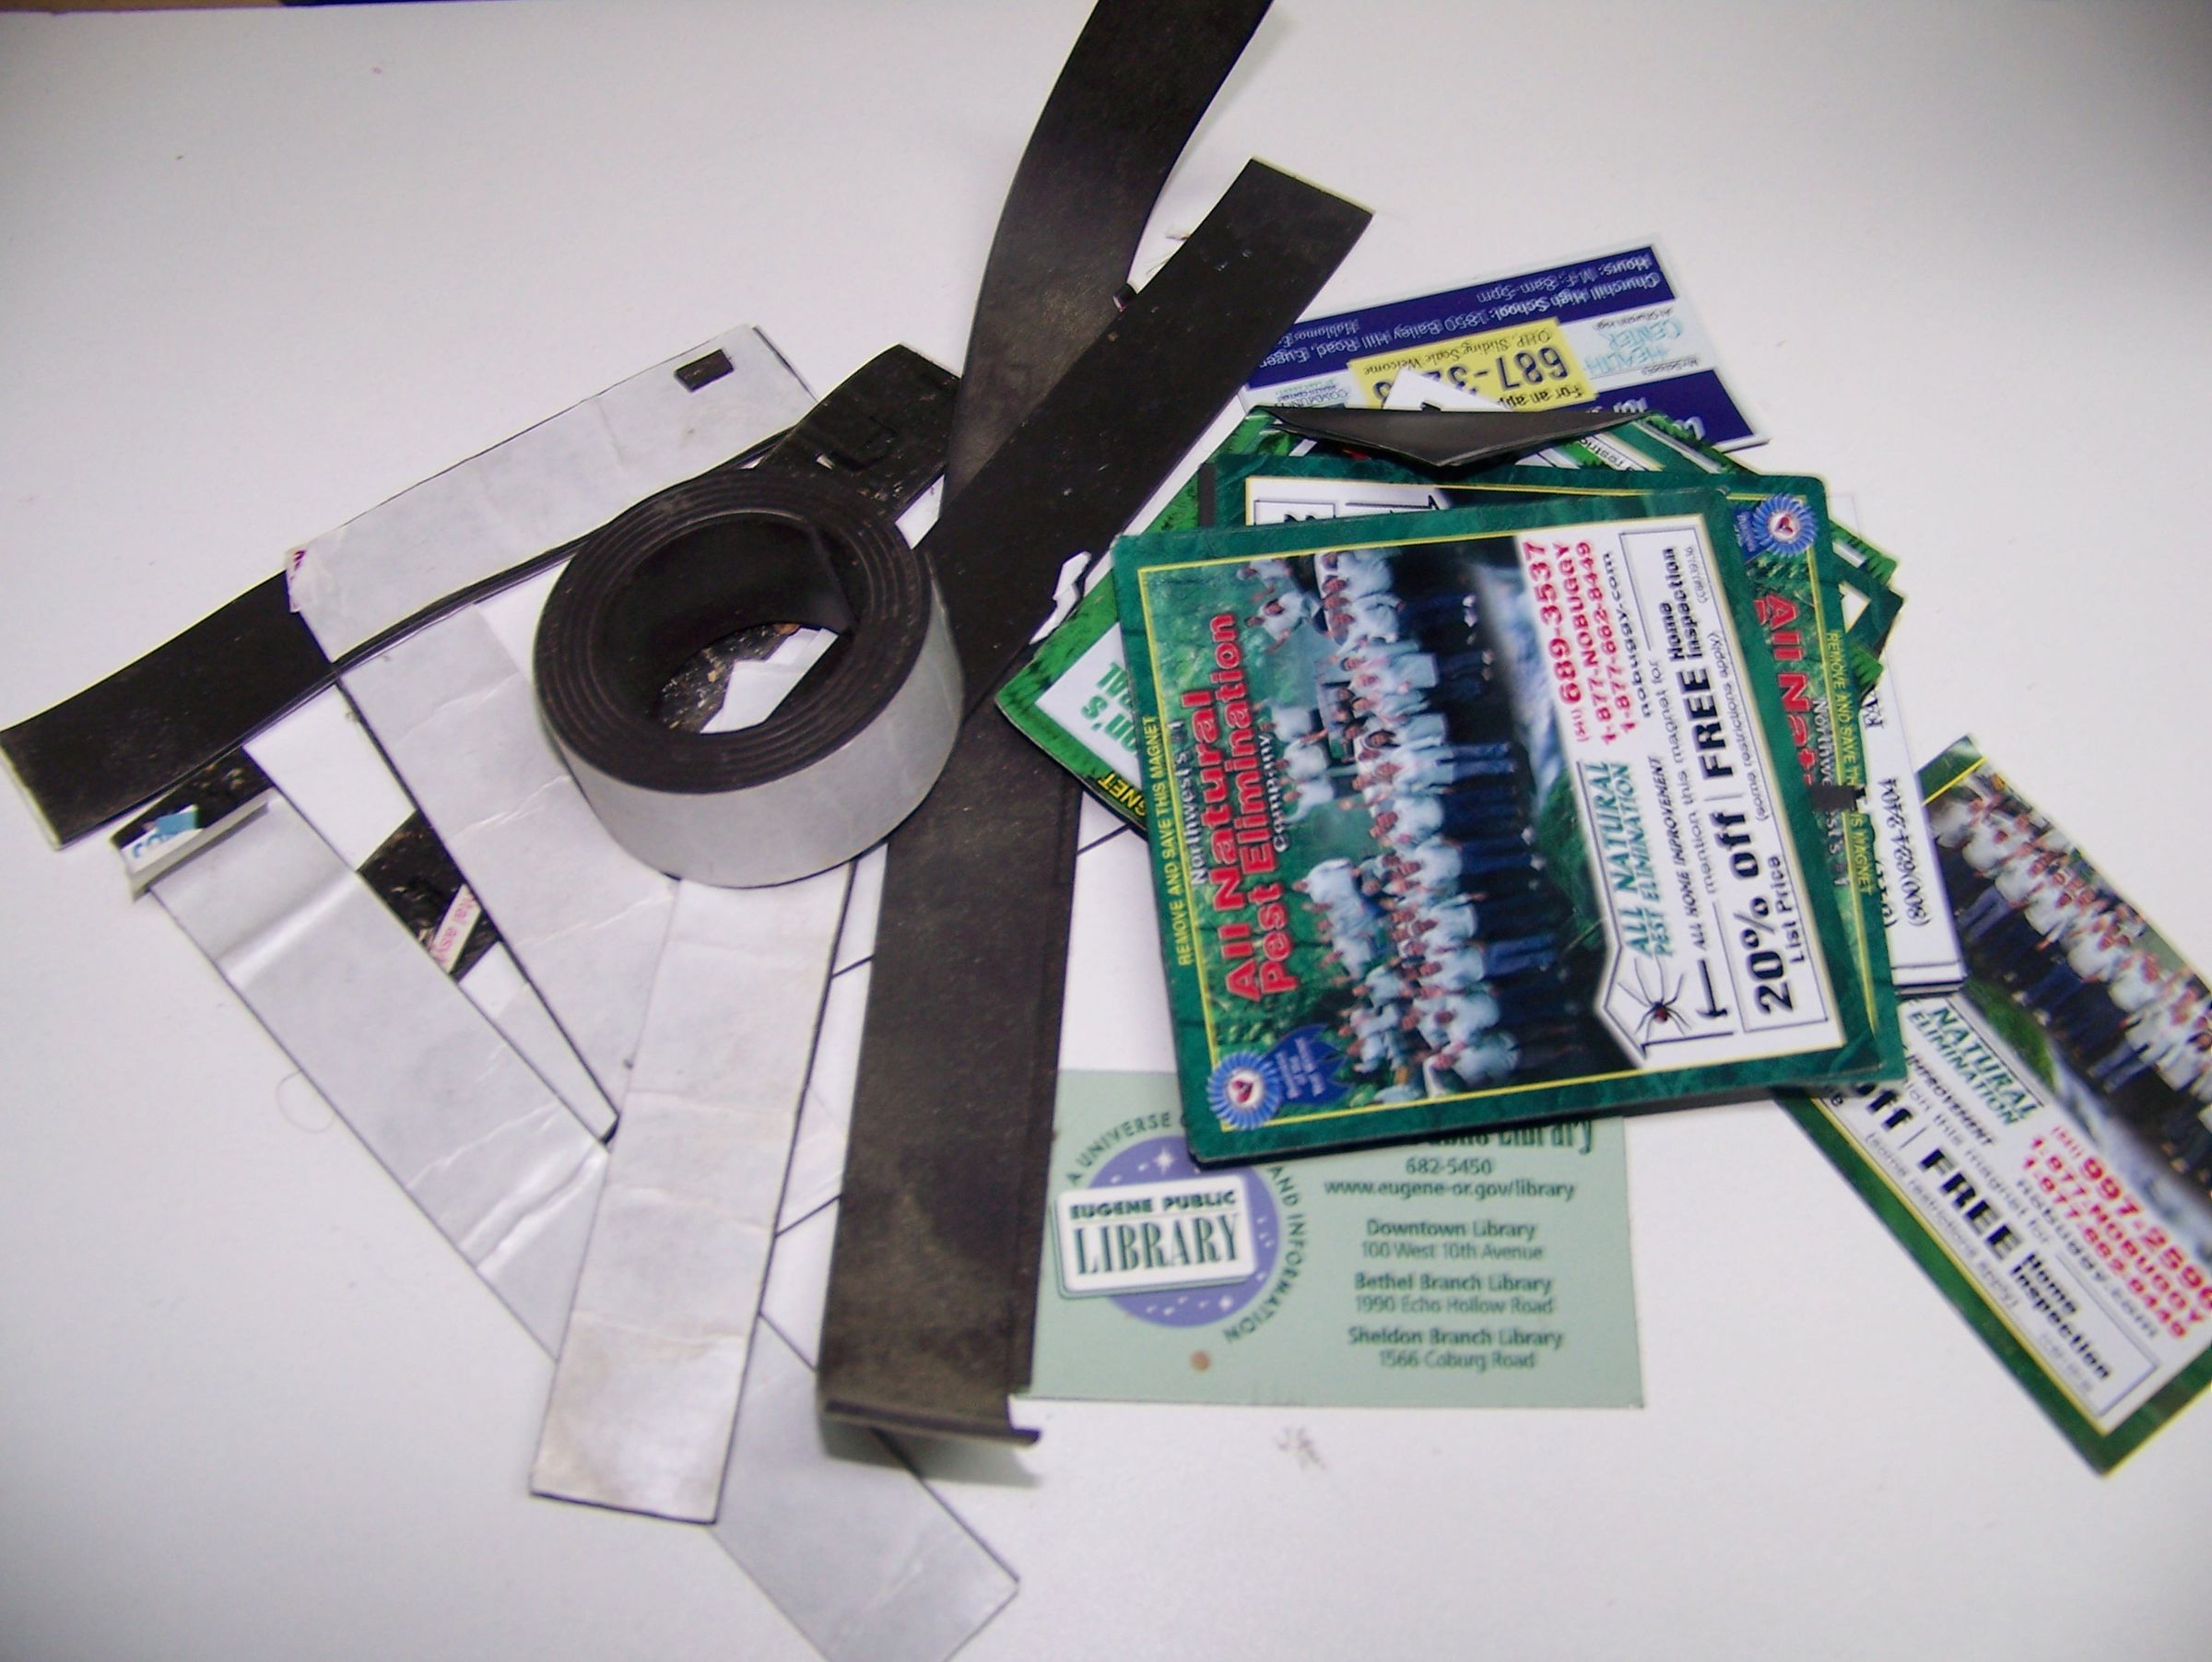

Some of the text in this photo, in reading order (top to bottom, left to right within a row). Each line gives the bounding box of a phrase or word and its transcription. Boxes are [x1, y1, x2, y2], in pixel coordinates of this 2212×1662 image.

[1548, 285, 1591, 310] High
[1588, 270, 1663, 301] Churchill
[1596, 253, 1655, 280] Hours:
[1293, 317, 1359, 348] Hablamos
[1360, 330, 1391, 350] Hill
[1392, 313, 1444, 344] Bailey
[1442, 309, 1488, 333] 1850
[1488, 295, 1551, 324] School:
[1598, 317, 1681, 353] CENTER
[1311, 333, 1360, 361] Road,
[1363, 354, 1421, 381] Welcome
[1424, 347, 1460, 366] Scale
[1460, 333, 1508, 358] Sliding
[1583, 343, 1669, 377] HEALTH
[1529, 391, 1550, 405] an
[1552, 383, 1583, 402] For
[1522, 538, 1583, 704] 689-3537
[1599, 551, 1654, 718] nobuggy.com
[1654, 601, 1685, 661] Home
[1658, 546, 1707, 659] Inspection
[1764, 594, 1804, 661] All
[1552, 539, 1618, 745] 1-877-NOBUGGY
[1574, 540, 1639, 734] 1-877-662-8449
[1825, 630, 1847, 690] REMOVE
[1675, 667, 1735, 779] FREE
[1705, 630, 1770, 821] (some restrictions apply)
[1833, 691, 1852, 724] AND
[1838, 725, 1857, 761] SAVE
[1202, 611, 1299, 994] Pest Elimination
[1255, 731, 1291, 854] Company
[1645, 659, 1718, 894] mention this magnet for
[1140, 713, 1194, 966] REMOVE AND SAVE THIS MAGNET
[1171, 751, 1209, 886] Northwest's
[1179, 688, 1262, 1004] All Natural
[1583, 759, 1653, 960] ALL NATURAL
[1609, 761, 1674, 959] PEST ELIMINATION
[1647, 754, 1708, 950] ALL HOME IMPROVEMENT
[1851, 830, 1875, 895] MAGNET
[1707, 807, 1796, 1015] 20% off
[1762, 855, 1806, 962] List Price
[1909, 1011, 2018, 1125] ELIMINATION
[1927, 1006, 2041, 1121] NATURAL
[1904, 1053, 1994, 1147] IMPROVEMENT
[1066, 1171, 1082, 1185] A
[1076, 1112, 1171, 1169] UNIVERSE
[1405, 1156, 1493, 1176] 682-5450
[1931, 1112, 1966, 1149] this
[1961, 1147, 2029, 1220] magnet
[2025, 1216, 2053, 1246] for
[1069, 1189, 1237, 1220] EUGENE PUBLIC
[1324, 1178, 1576, 1202] www.eugene-or.gov/library
[1905, 1177, 1980, 1260] restrictions
[1914, 1145, 2023, 1261] FREE
[1072, 1212, 1239, 1276] LIBRARY
[1223, 1165, 1306, 1343] AND INFORMATION
[1362, 1242, 1544, 1260] 100 West 10th Avenue
[1367, 1218, 1536, 1242] Downtown Library
[1354, 1272, 1553, 1295] Bethel Branch Library
[1356, 1295, 1554, 1314] 1990 Echo Hollow Road
[2022, 1249, 2083, 1316] Home
[1347, 1326, 1564, 1351] Sheldon Branch Library
[2006, 1263, 2113, 1383] Inspection
[1379, 1350, 1536, 1373] 1566 Coburg Road
